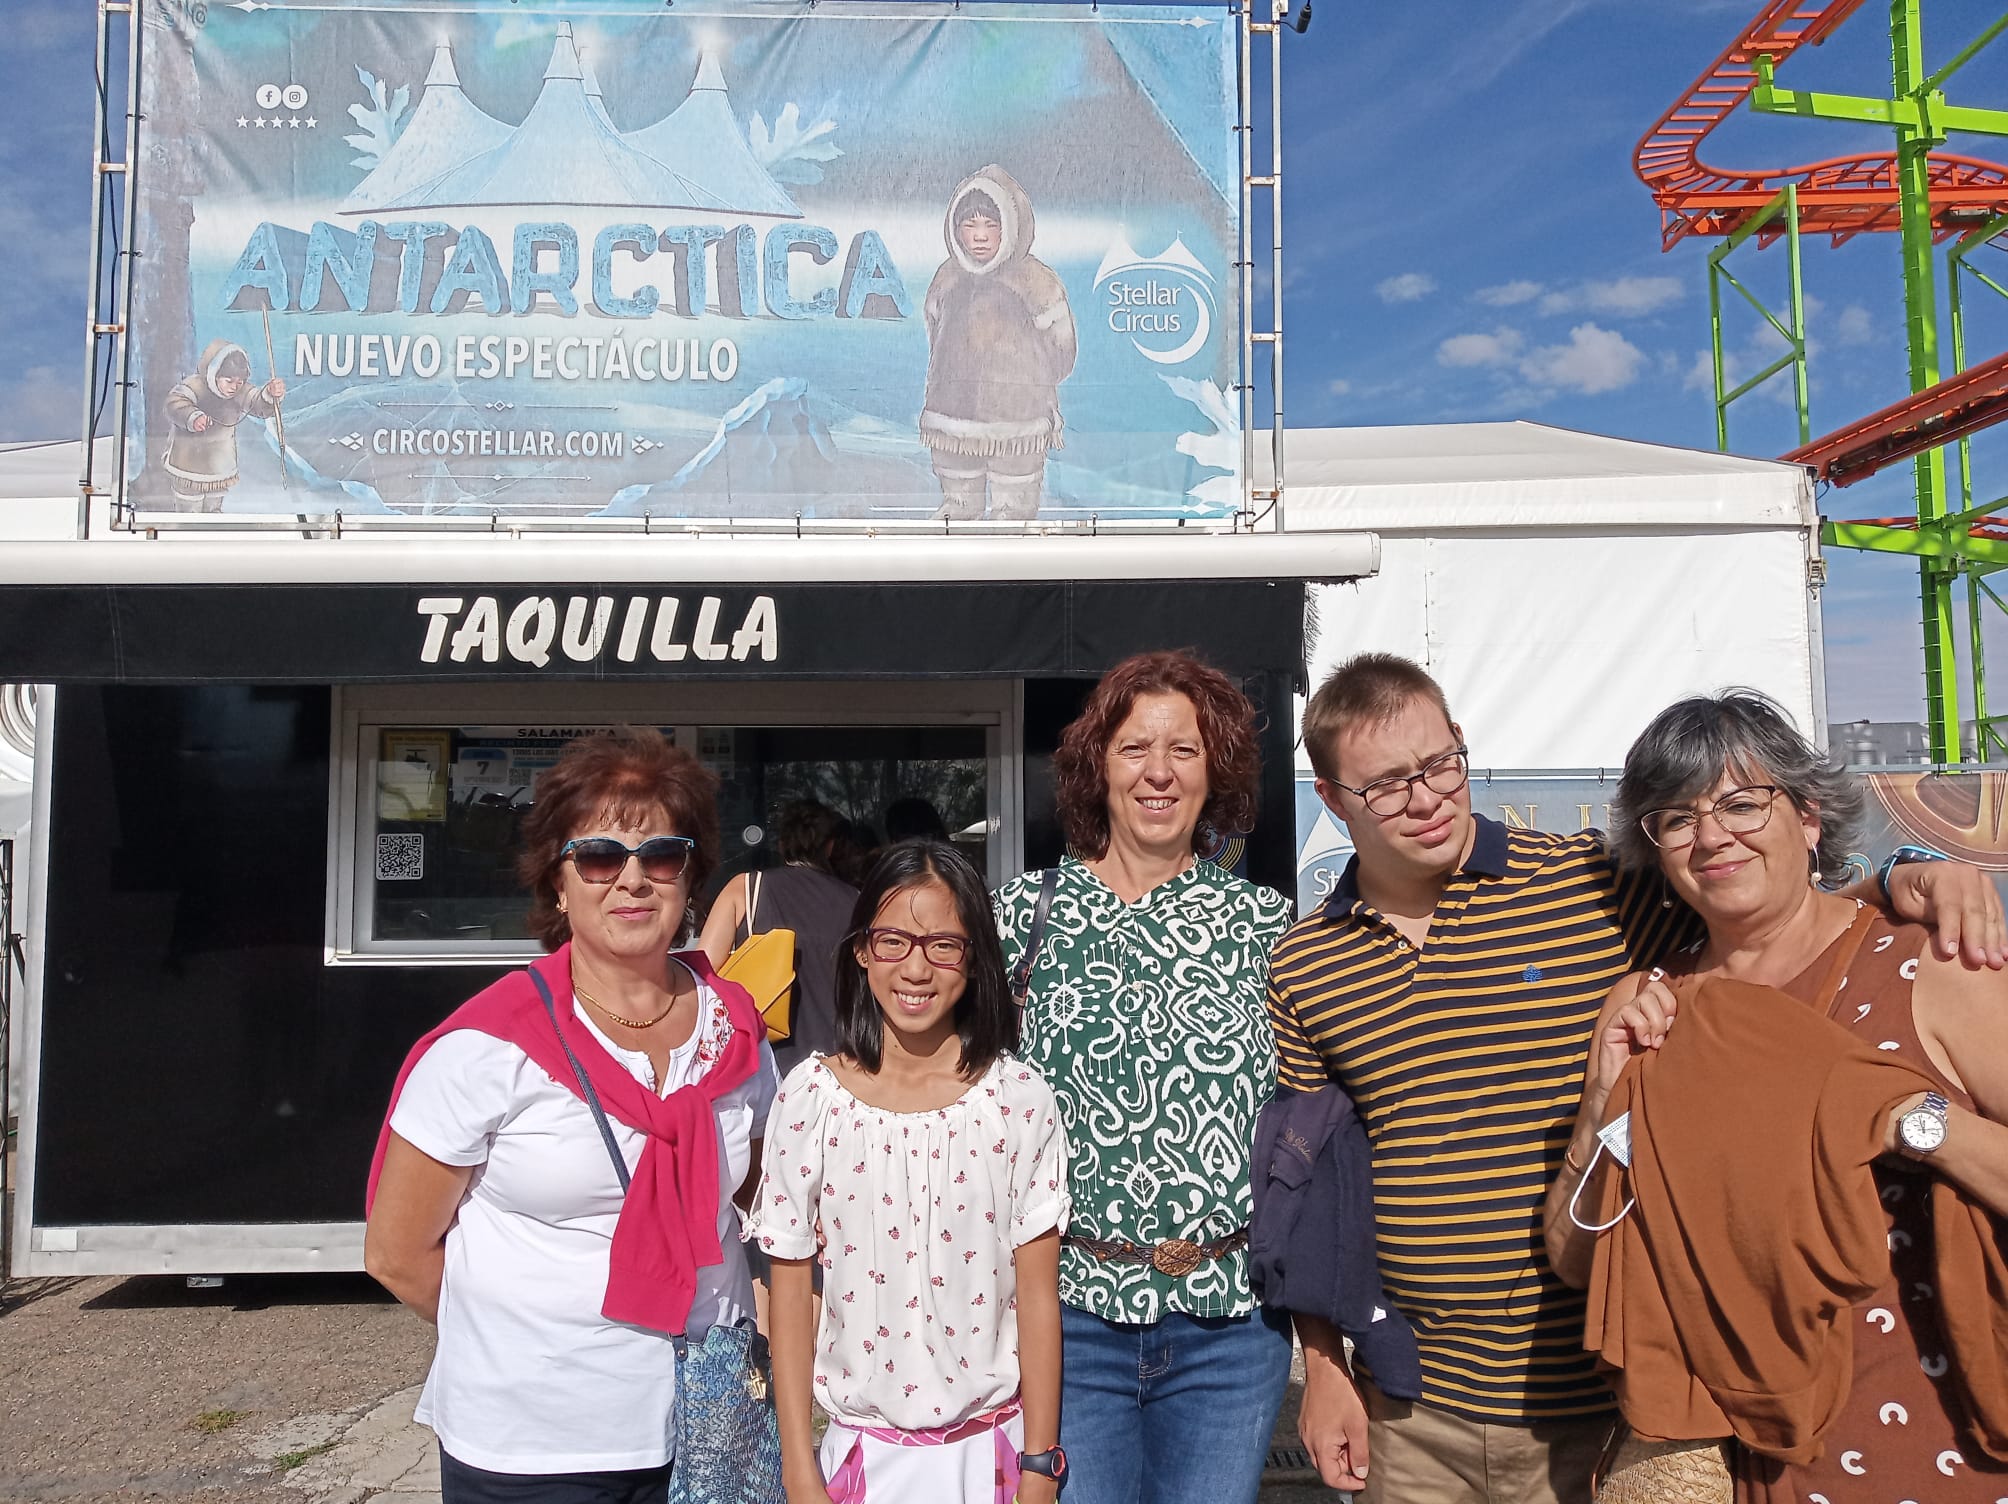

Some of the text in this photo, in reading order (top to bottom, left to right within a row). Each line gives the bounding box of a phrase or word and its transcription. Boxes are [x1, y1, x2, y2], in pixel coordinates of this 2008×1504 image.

[224, 219, 911, 319] ANTARCTICA
[1108, 281, 1181, 307] Stellar
[1108, 308, 1181, 333] Circus
[294, 327, 739, 382] NUEVO ESPECTÁCULO
[372, 428, 624, 459] CIRCOSTELLAR.COM
[417, 596, 778, 668] TAQUILLA
[1312, 867, 1340, 896] St
